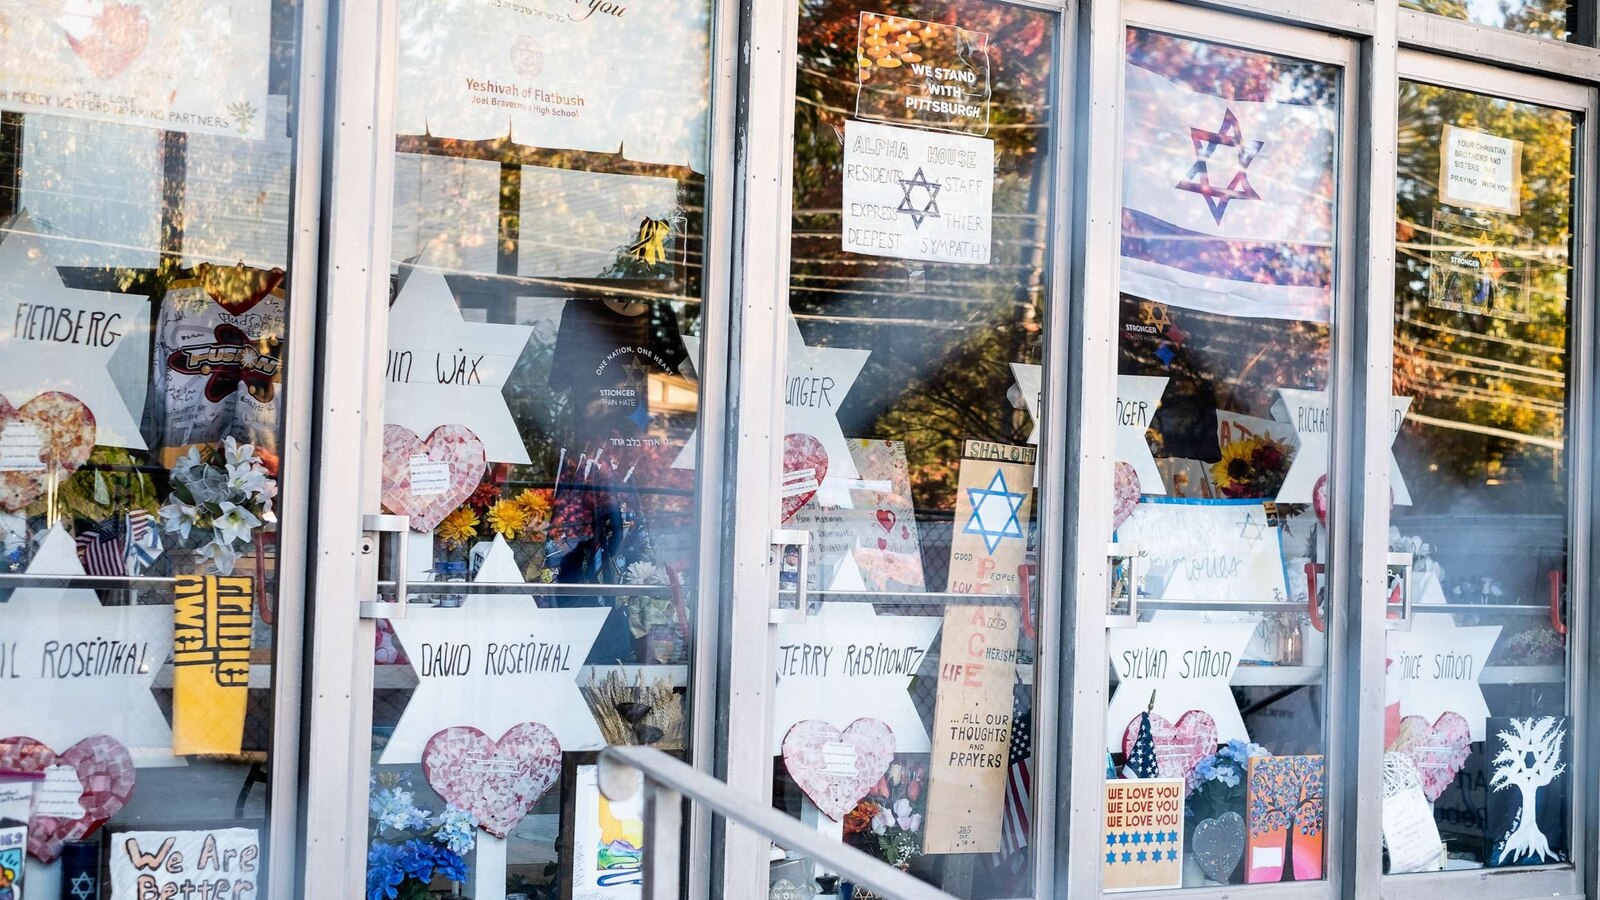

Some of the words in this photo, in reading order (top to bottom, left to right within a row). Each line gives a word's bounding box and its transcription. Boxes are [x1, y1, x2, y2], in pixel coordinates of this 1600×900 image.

[911, 63, 932, 77] WE
[935, 67, 977, 83] STAND
[466, 78, 519, 97] Yeshivah
[521, 87, 533, 99] of
[534, 89, 585, 107] Flatbush
[928, 83, 962, 98] WITH
[471, 95, 489, 105] Joel
[533, 105, 551, 117] High
[551, 107, 580, 118] School
[905, 97, 981, 118] PITTSBURGH
[169, 111, 230, 129] PARTNERS
[852, 136, 909, 160] ALPHA
[927, 145, 977, 169] HOUSE
[1454, 150, 1488, 163] BROTHERS
[1457, 139, 1475, 150] YOUR
[1476, 142, 1507, 156] CHRISTIAN
[1454, 160, 1480, 172] SISTERS
[847, 163, 905, 185] RESIDENTS
[944, 177, 984, 195] STAFF
[1450, 174, 1478, 187] PRAYING
[1481, 181, 1497, 191] WITH
[851, 202, 899, 222] EXPRESS
[944, 212, 984, 231] THIER
[848, 228, 902, 249] DEEPEST
[920, 237, 989, 260] SYMPATHY
[1450, 256, 1480, 268] STRONGER
[14, 302, 122, 347] FIENBERG
[1125, 323, 1158, 334] STRONGER
[435, 352, 484, 386] WAX
[595, 360, 608, 376] ONE
[636, 346, 653, 358] ONE
[653, 354, 674, 377] HEART
[600, 389, 636, 397] STRONGER
[619, 399, 636, 407] HATE
[970, 441, 1036, 464] SHALOM
[953, 552, 973, 562] GOOD
[41, 640, 150, 679] ROSENTHAL
[421, 642, 472, 678] DAVID
[485, 642, 571, 676] ROSENTHAL
[779, 644, 834, 678] JERRY
[843, 643, 925, 678] RABINOWITZ
[1122, 647, 1168, 679] SYLVAN
[1179, 649, 1232, 679] SIMON
[1432, 653, 1473, 680] SIMON
[986, 713, 1009, 726] OUR
[950, 727, 1007, 743] THOUGHTS
[968, 743, 985, 752] AND
[949, 751, 1002, 769] PRAYERS
[1107, 788, 1124, 800] WE
[1126, 787, 1154, 800] LOVE
[1156, 786, 1180, 798] YOU
[1107, 802, 1123, 814] WE
[1126, 801, 1153, 813] LOVE
[1156, 800, 1179, 812] YOU
[1106, 816, 1123, 828] WE
[1125, 815, 1153, 827] LOVE
[1156, 814, 1179, 826] YOU
[125, 836, 184, 874] We
[197, 833, 259, 873] Are
[137, 873, 254, 900] Better
